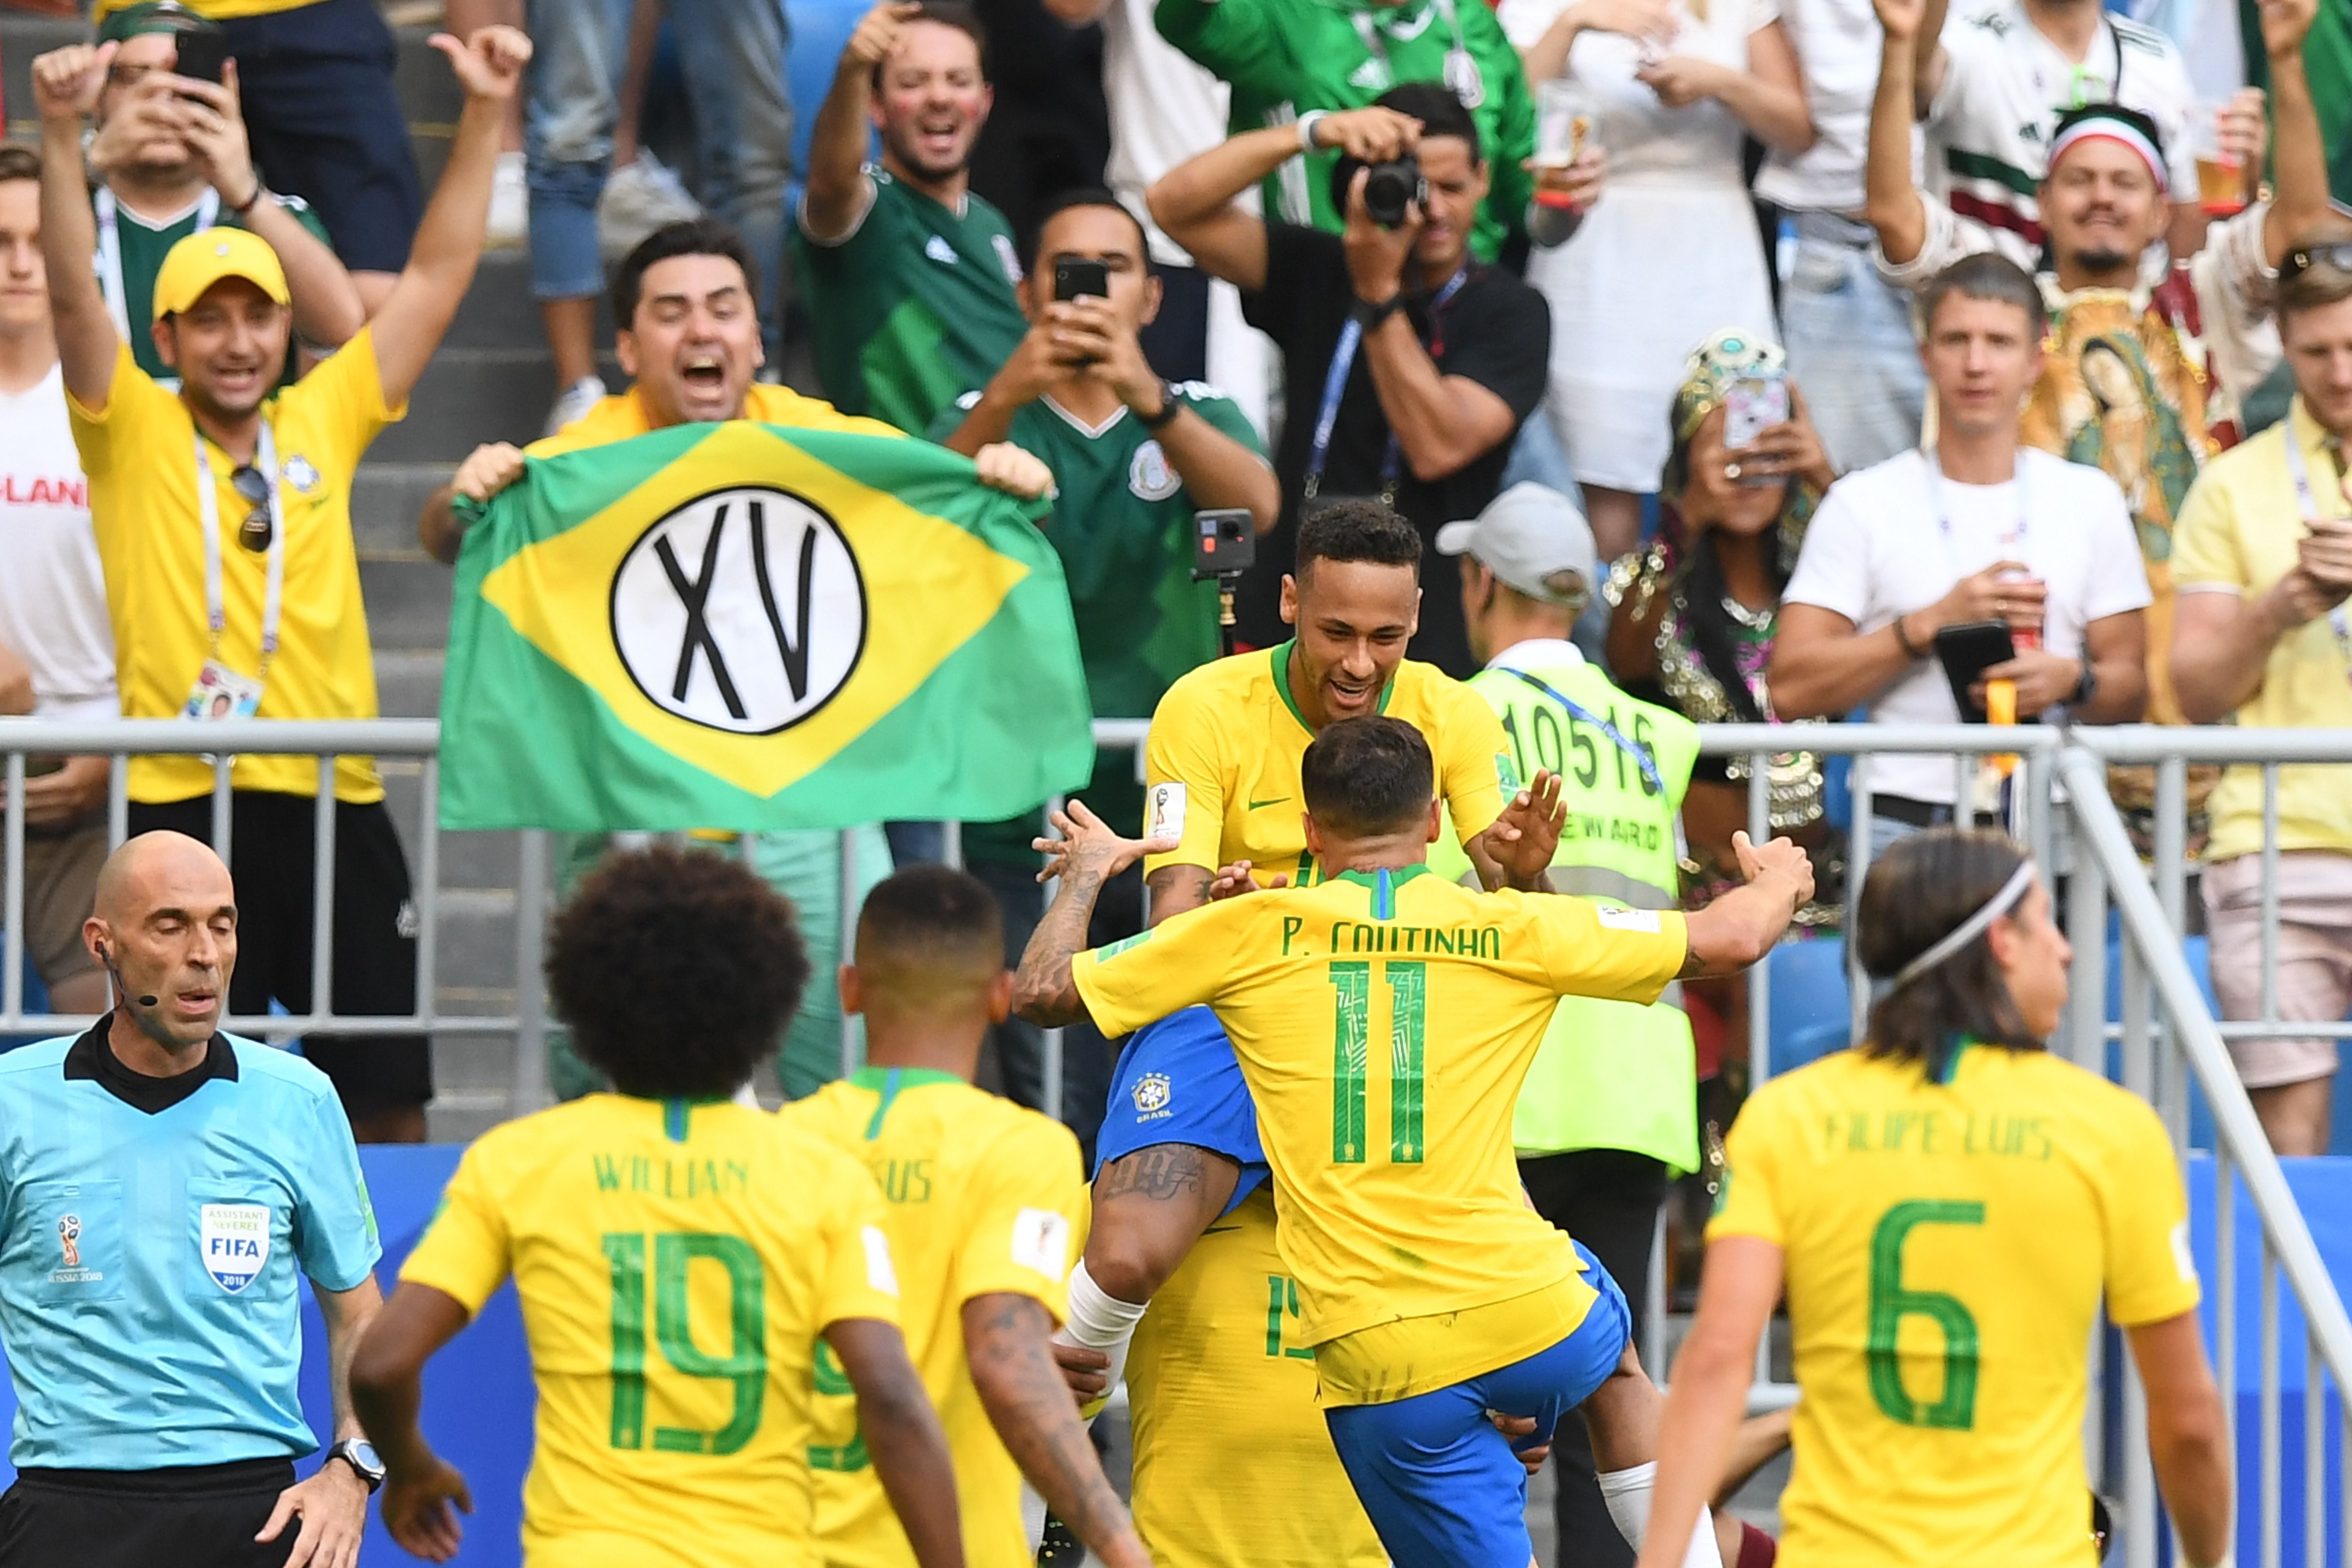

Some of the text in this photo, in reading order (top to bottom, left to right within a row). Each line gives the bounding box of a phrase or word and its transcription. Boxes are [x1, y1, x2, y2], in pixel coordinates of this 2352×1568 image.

[0, 477, 91, 506] LAN
[654, 501, 816, 719] XV
[1282, 916, 1310, 956] P.
[1328, 961, 1426, 1163] 11
[1963, 1112, 2053, 1161] LUIS
[209, 1210, 263, 1219] ASSISTANT
[211, 1238, 259, 1258] FIFA
[223, 1275, 245, 1286] 2018
[1869, 1200, 1984, 1430] 6
[602, 1233, 768, 1456] 19
